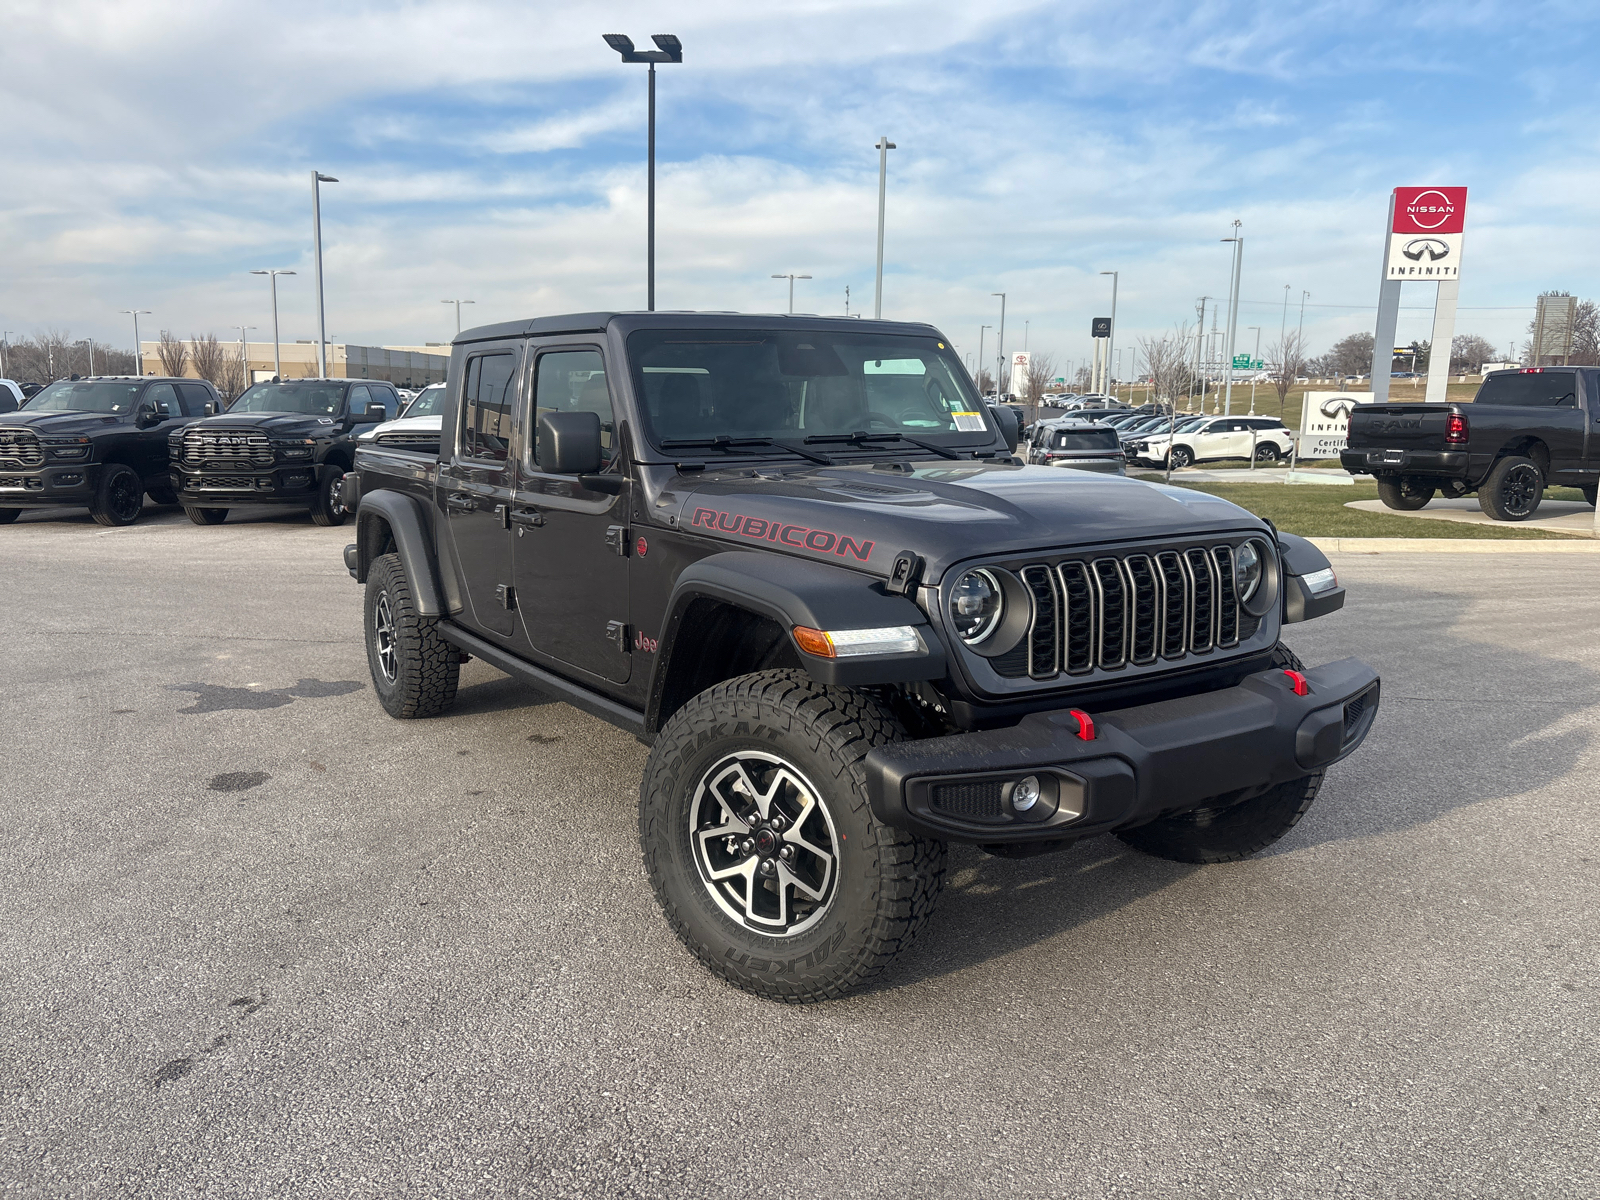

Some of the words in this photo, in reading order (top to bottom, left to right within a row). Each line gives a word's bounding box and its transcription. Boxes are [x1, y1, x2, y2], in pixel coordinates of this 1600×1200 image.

[1391, 267, 1457, 275] INFINITI
[1372, 420, 1422, 429] RAM
[1318, 439, 1347, 447] Certifi
[1313, 447, 1340, 455] Pre-O
[692, 507, 876, 562] RUBICON
[635, 630, 658, 654] Jee
[724, 921, 848, 976] FALKEN
